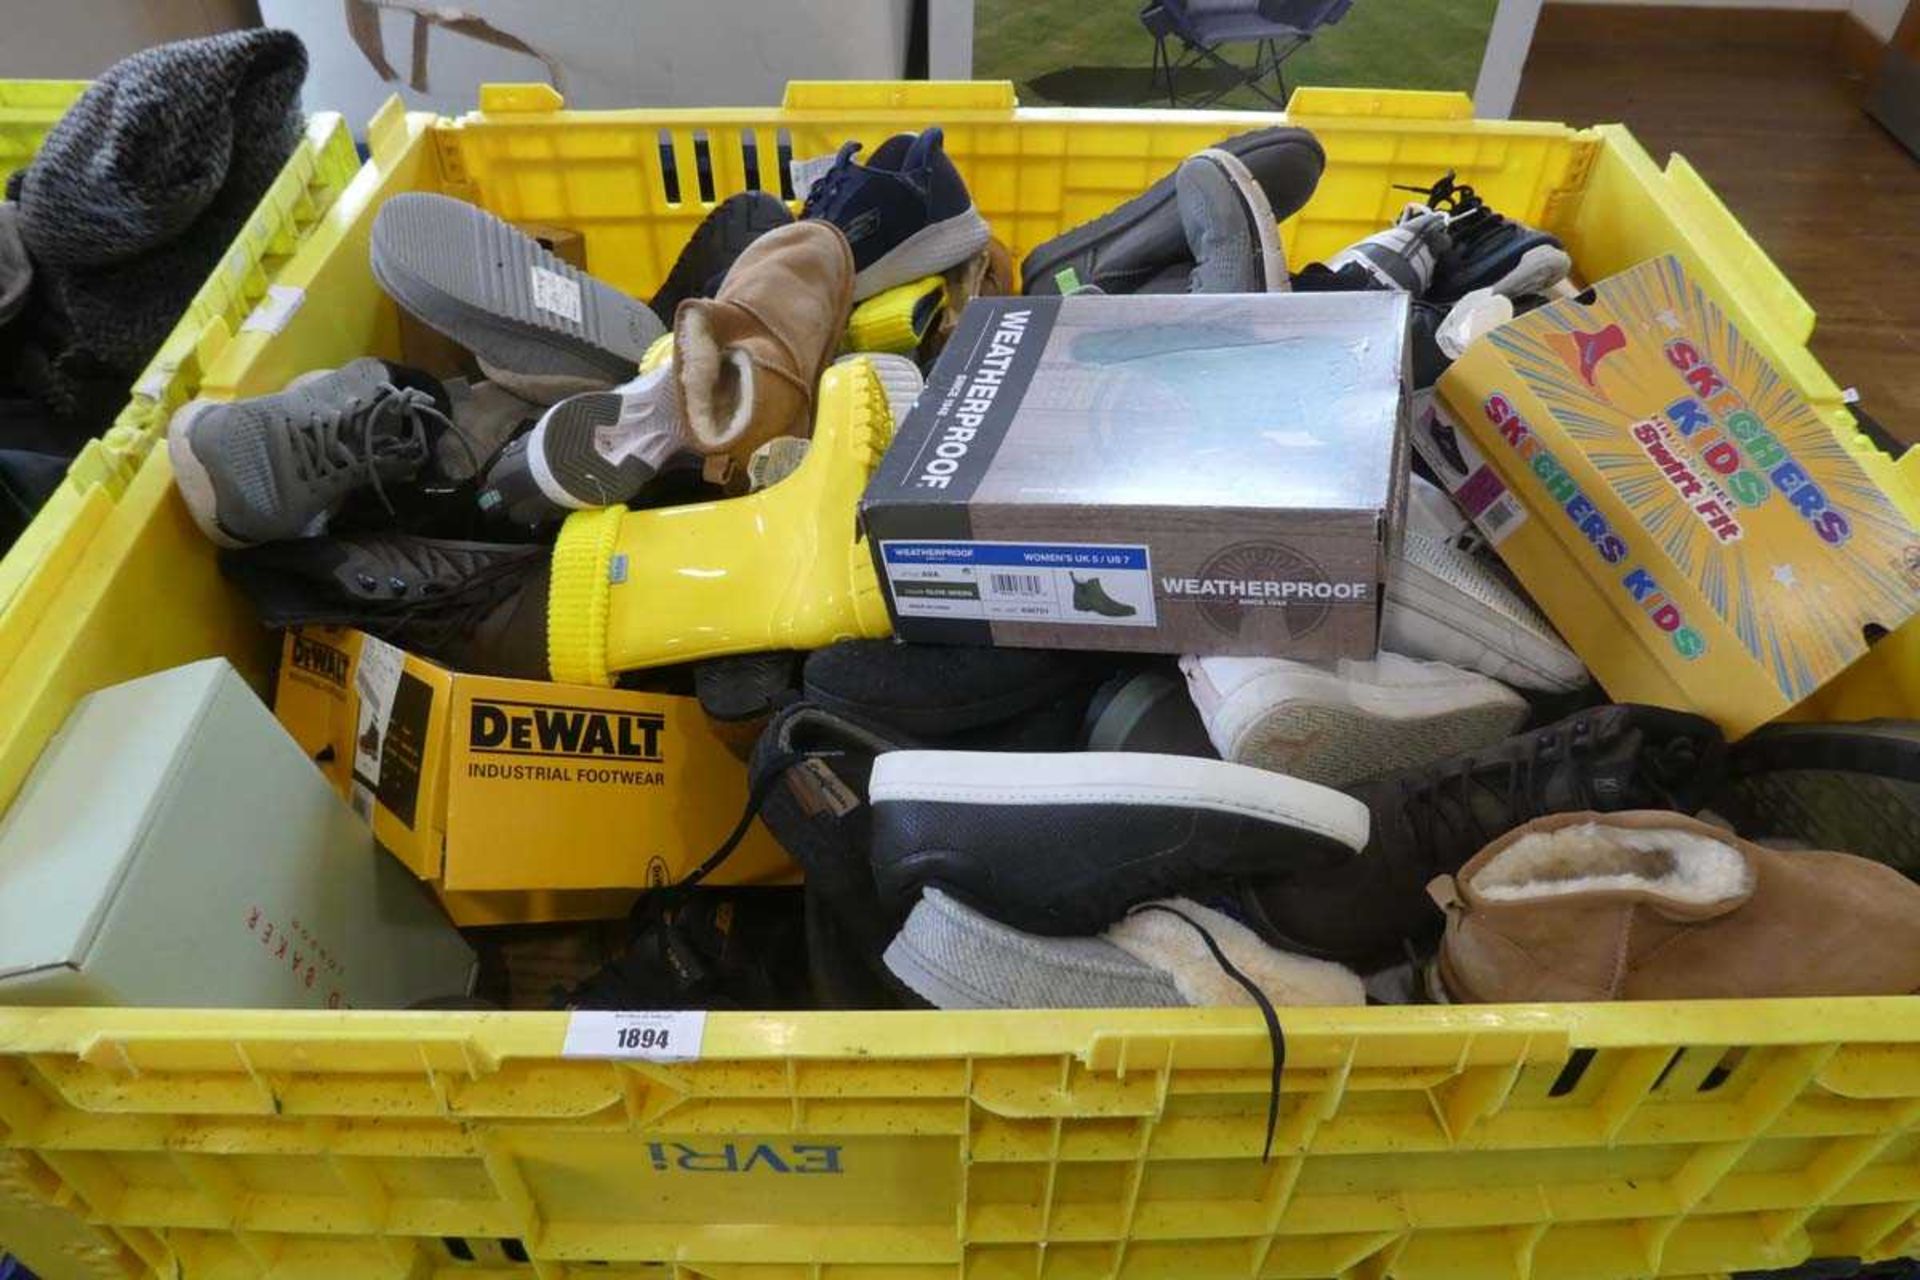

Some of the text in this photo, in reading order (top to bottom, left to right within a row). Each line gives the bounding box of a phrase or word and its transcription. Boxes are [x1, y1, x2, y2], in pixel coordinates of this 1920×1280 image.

[920, 310, 1032, 489] WEATHERPROOF
[1666, 340, 1850, 545] SKECHERS
[1666, 397, 1768, 507] KIDS
[1023, 552, 1073, 563] WOMEN'S
[1075, 554, 1091, 563] UK
[1107, 555, 1122, 564] US
[1484, 394, 1704, 660] SKECHERS KIDS
[1161, 577, 1368, 599] WEATHERPROOF
[468, 763, 665, 785] INDUSTRIAL FOOTWEAR
[246, 905, 316, 989] BAKER
[617, 1028, 669, 1049] 1894
